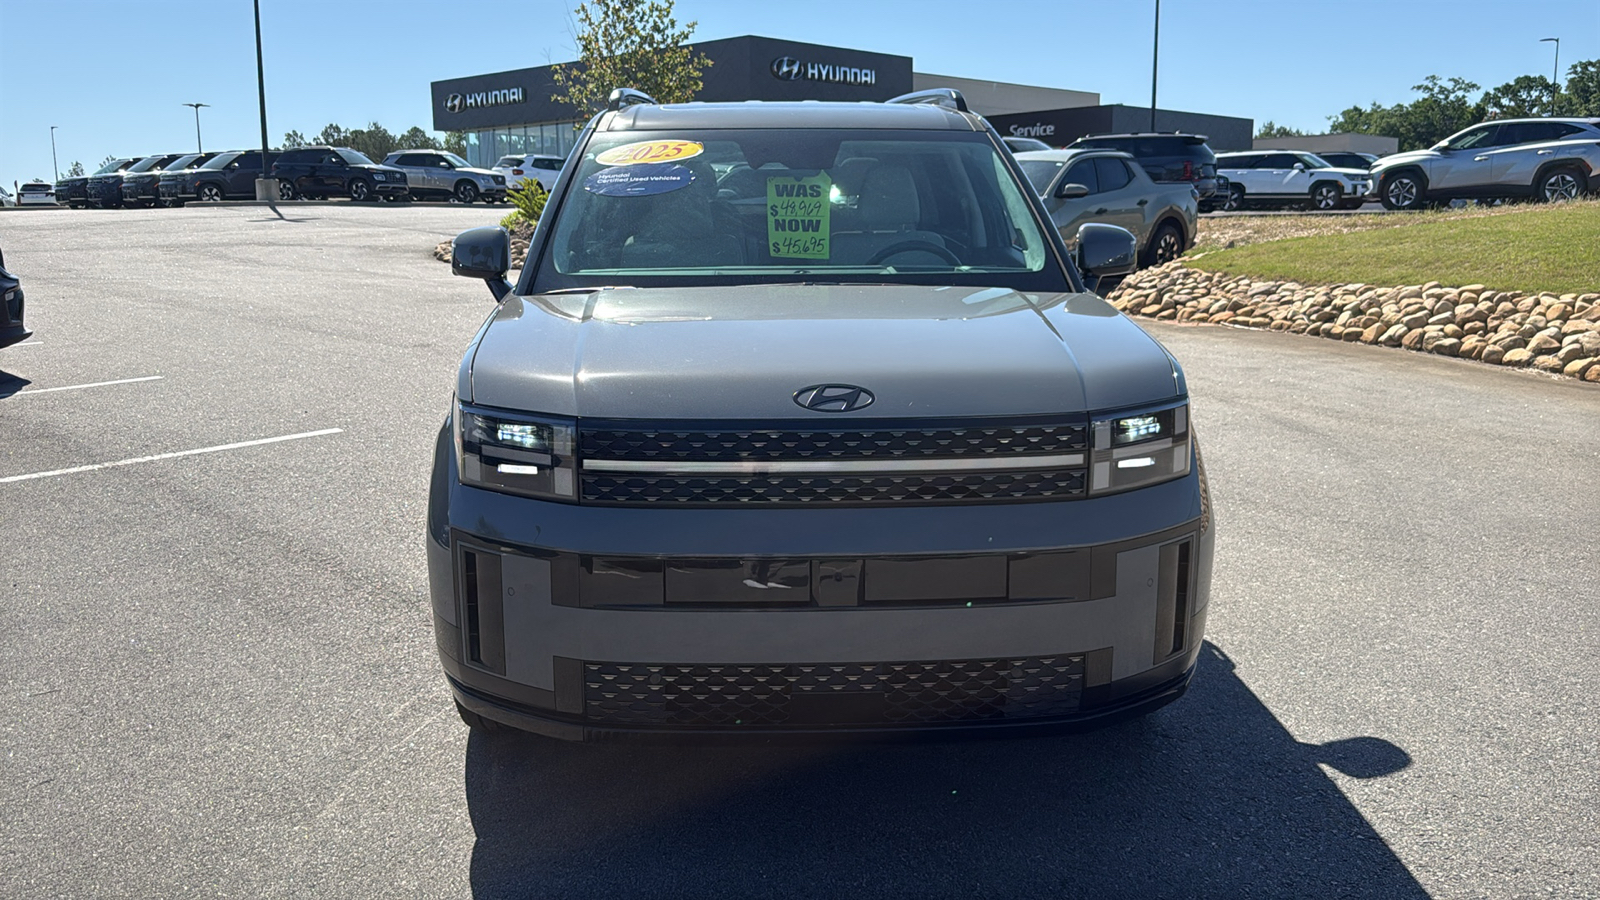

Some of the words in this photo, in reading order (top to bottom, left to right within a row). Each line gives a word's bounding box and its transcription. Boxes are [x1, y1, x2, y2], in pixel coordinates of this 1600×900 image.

[807, 62, 876, 84] HYUNDAI
[466, 87, 523, 107] HYUNDAI
[1009, 122, 1055, 137] Service
[614, 143, 688, 162] 2025
[598, 172, 631, 180] Hyundai
[774, 183, 822, 198] WAS
[774, 218, 822, 233] NOW
